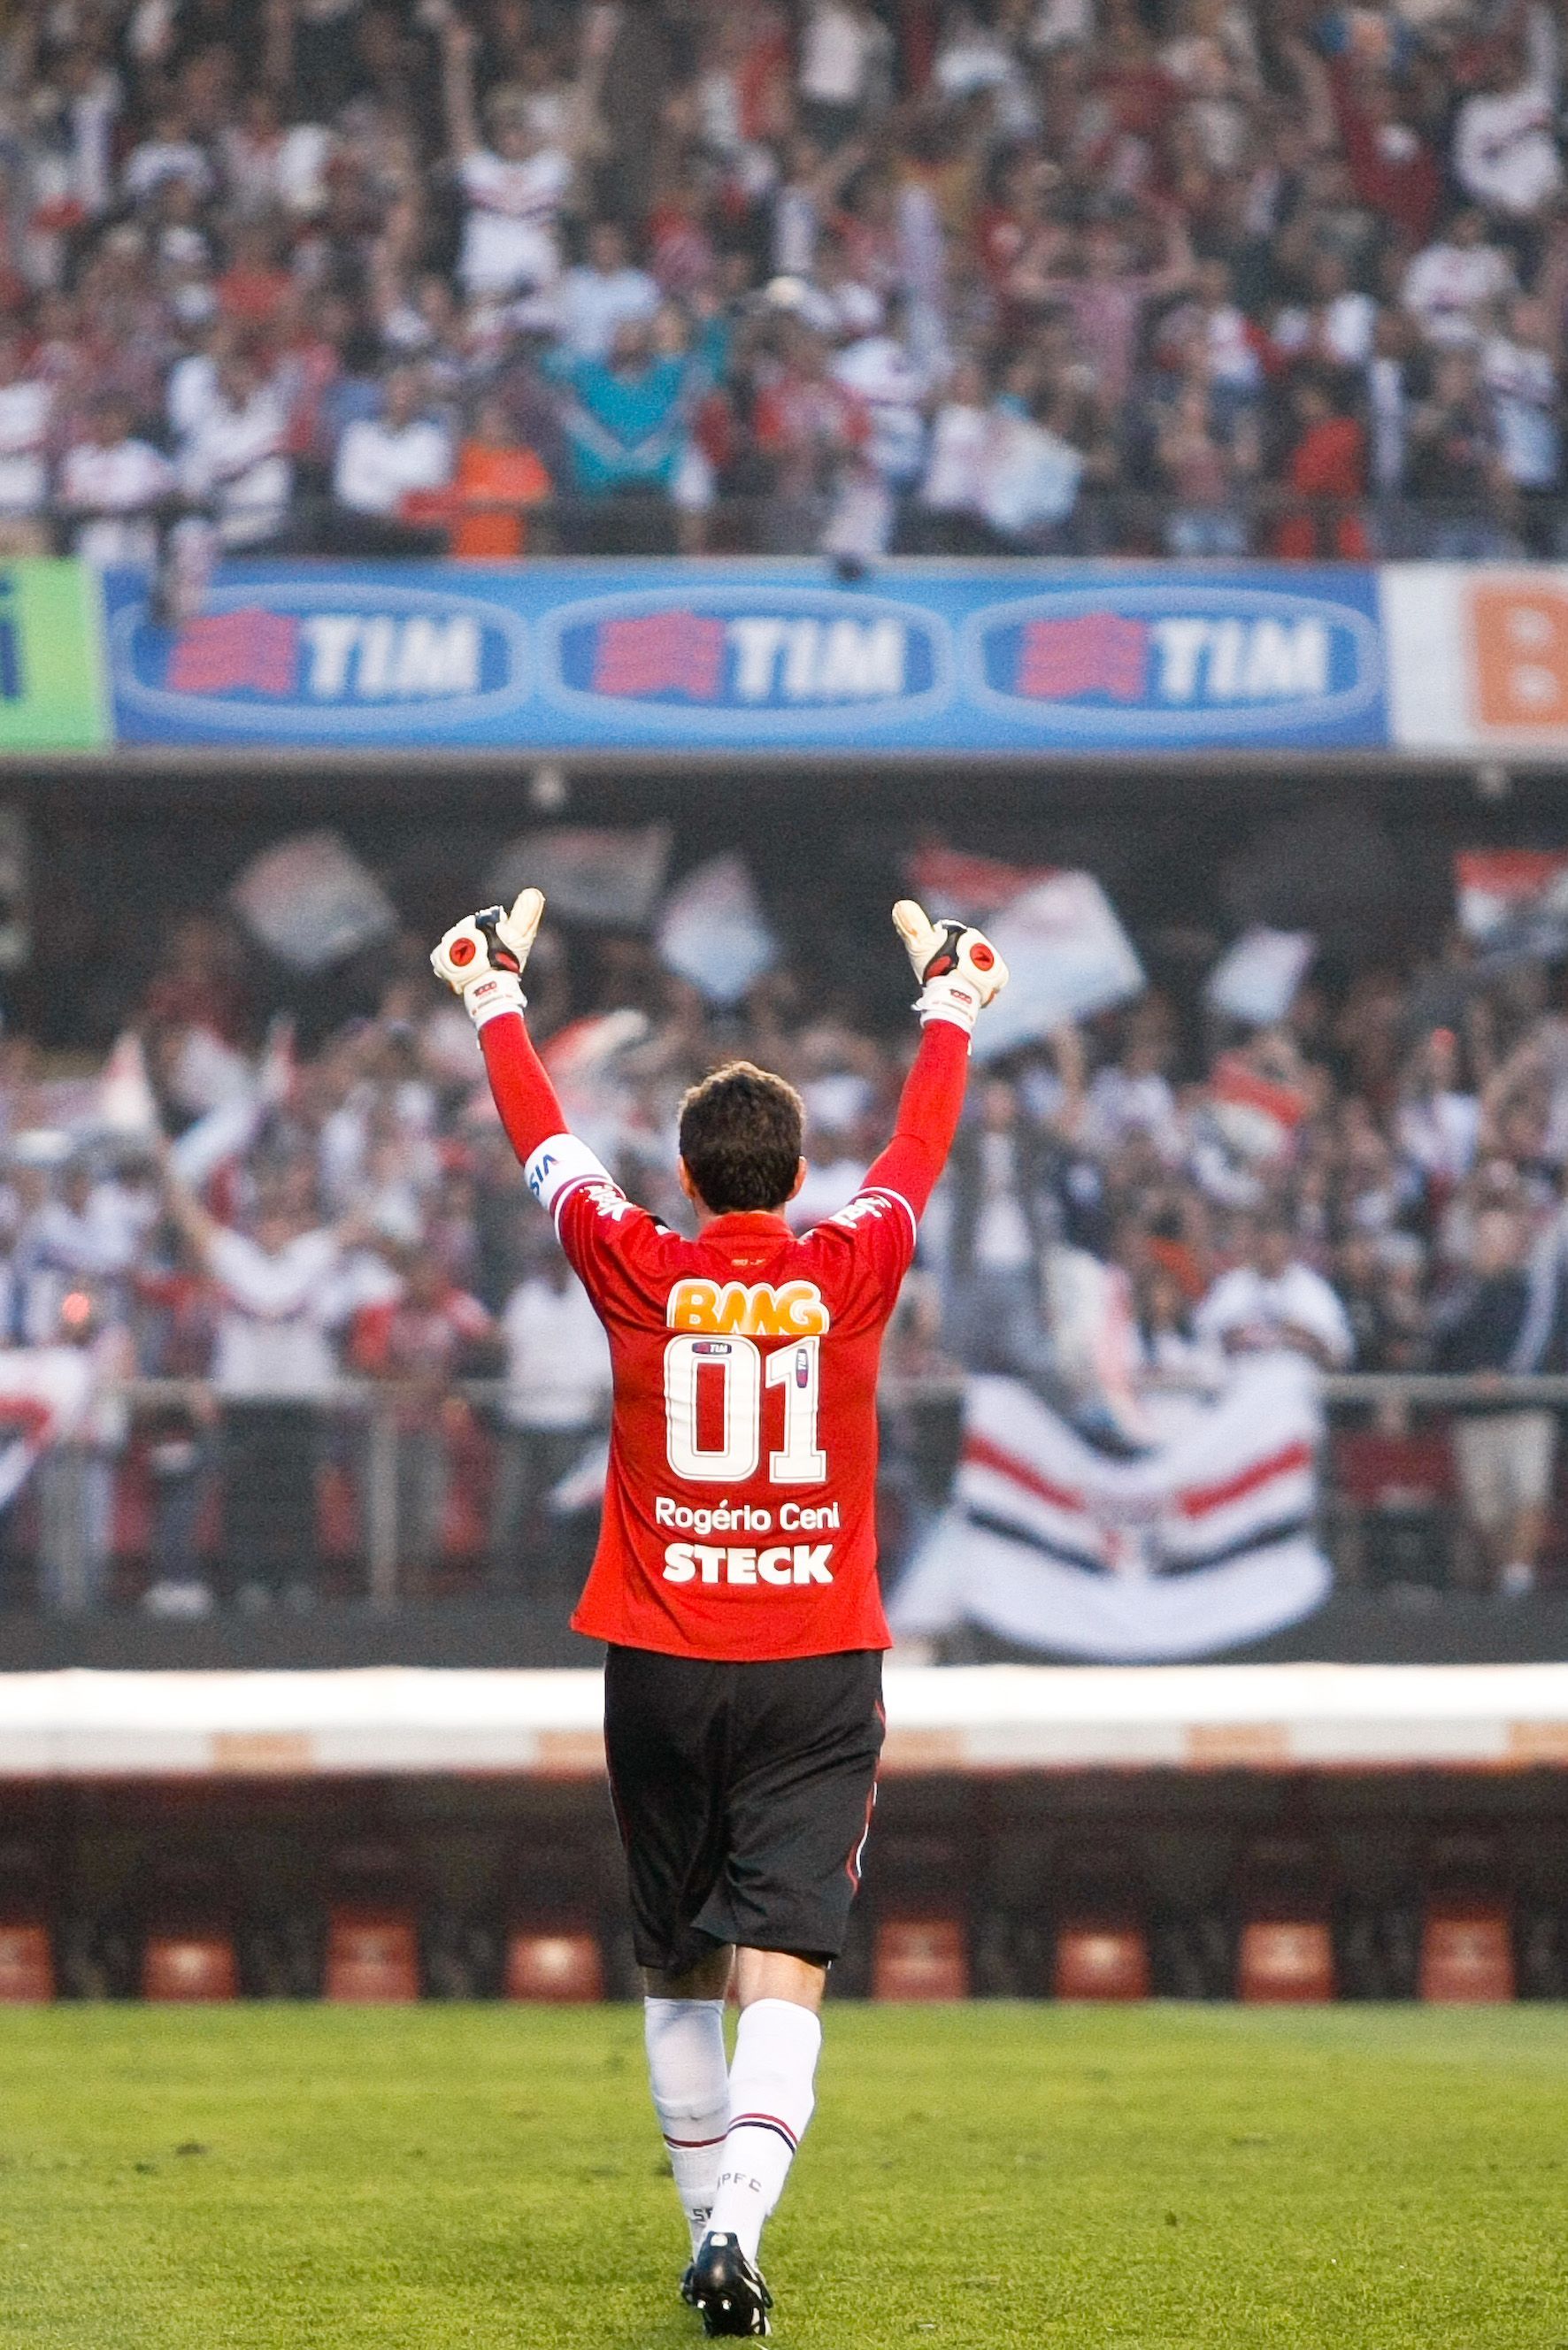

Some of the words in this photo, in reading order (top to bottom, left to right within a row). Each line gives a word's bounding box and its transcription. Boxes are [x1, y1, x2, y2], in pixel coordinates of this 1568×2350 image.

[304, 615, 481, 697] TIM
[727, 617, 905, 699] TIM
[1151, 618, 1329, 700] TIM
[666, 1279, 830, 1335] BMG
[664, 1334, 826, 1483] 01
[656, 1496, 772, 1535] Rogério
[780, 1501, 841, 1531] Ceni
[663, 1542, 834, 1585] STECK
[717, 2172, 762, 2193] PFC
